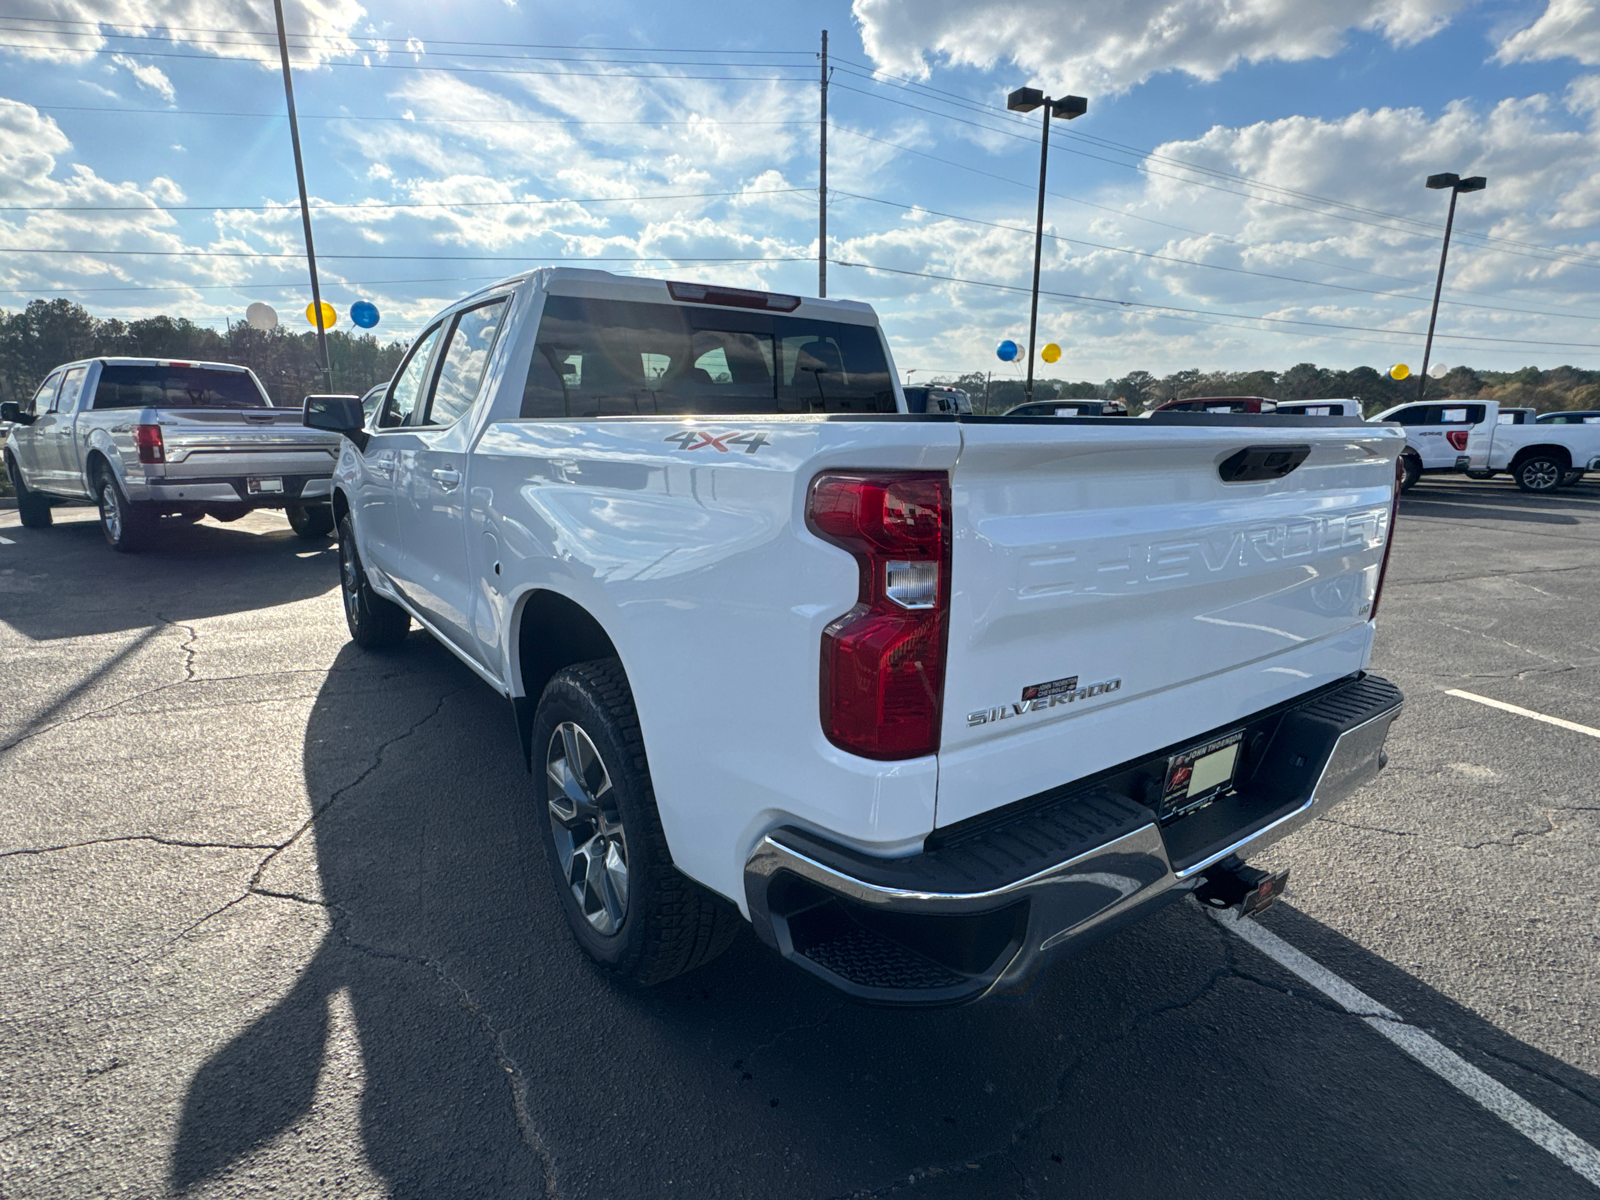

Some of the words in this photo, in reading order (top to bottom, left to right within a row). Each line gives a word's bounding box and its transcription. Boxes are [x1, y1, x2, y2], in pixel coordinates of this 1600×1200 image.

[1017, 507, 1389, 600] CHEVROLET
[1038, 686, 1067, 697] CHEVROLET
[1039, 683, 1052, 691] JOHN
[1052, 678, 1077, 687] THORNTON
[966, 677, 1122, 728] SILVERADO
[1187, 746, 1207, 760] JOHN
[1207, 732, 1243, 752] THORNTON
